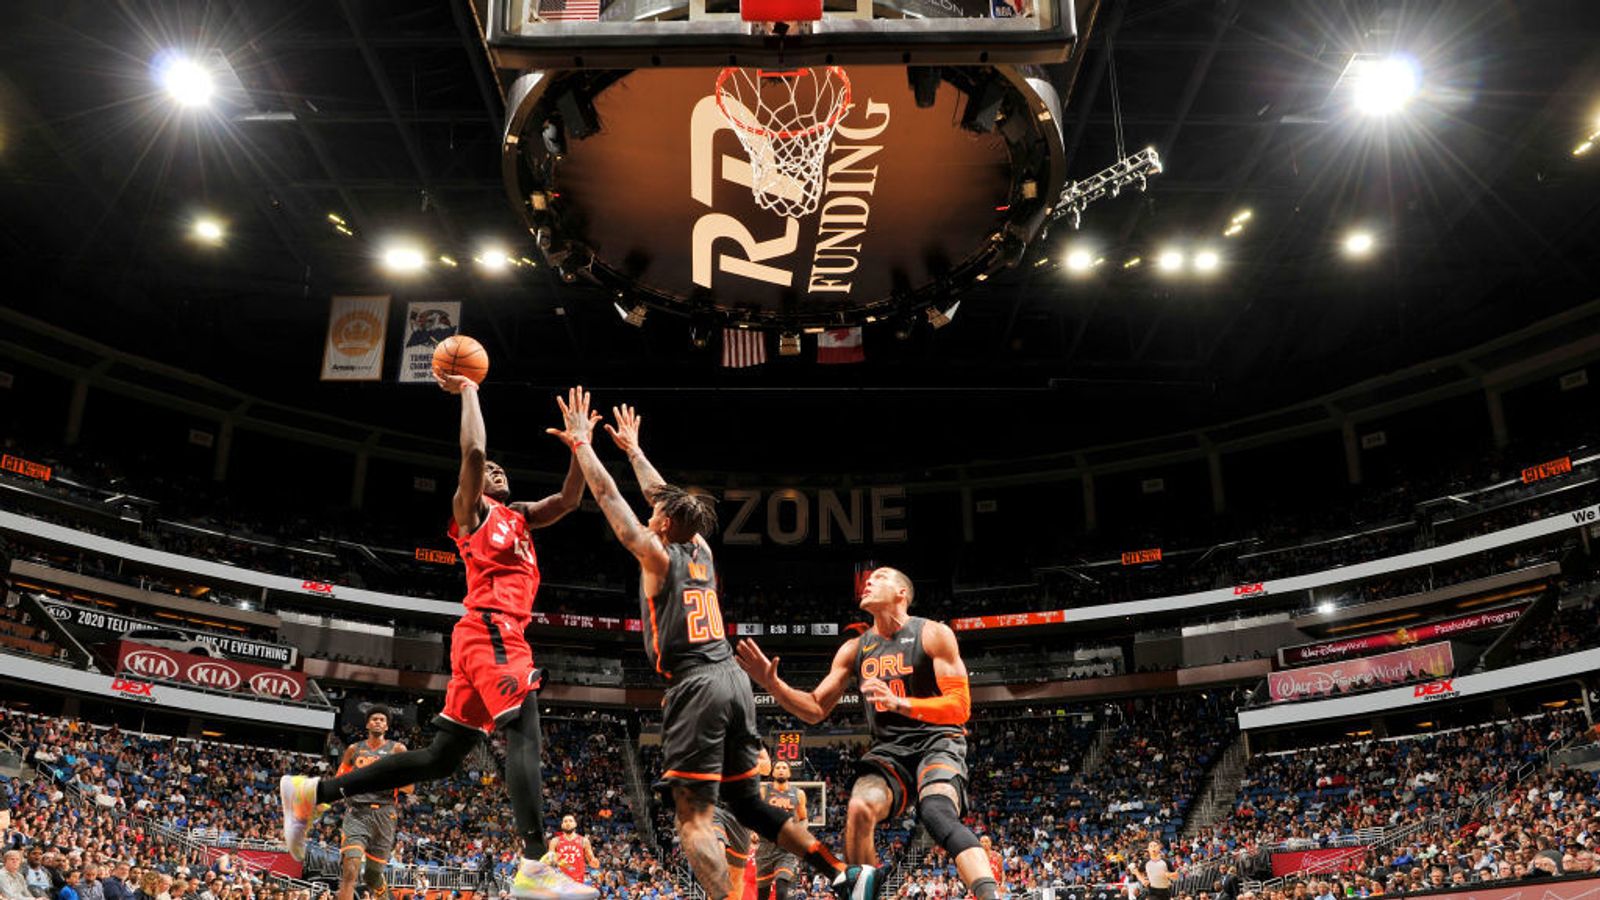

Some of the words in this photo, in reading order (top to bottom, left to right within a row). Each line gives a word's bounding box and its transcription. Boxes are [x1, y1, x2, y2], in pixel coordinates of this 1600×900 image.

[808, 98, 890, 294] FUNDING
[720, 487, 908, 545] ZONE
[1572, 510, 1595, 523] We
[302, 581, 334, 592] DEX
[1233, 583, 1264, 595] DEX
[683, 589, 726, 643] 20
[1481, 610, 1520, 625] Program
[49, 606, 68, 618] KIA
[78, 611, 104, 628] 2020
[220, 639, 230, 650] IT
[231, 640, 289, 661] EVERYTHING
[134, 654, 171, 677] KIA
[861, 652, 914, 680] ORL
[197, 667, 231, 687] KIA
[258, 677, 291, 695] KIA
[1276, 673, 1312, 697] Walt
[1371, 660, 1414, 681] World
[112, 679, 154, 696] DEX
[1414, 680, 1454, 697] DEX
[754, 695, 775, 705] GHT
[776, 742, 799, 760] 20
[563, 853, 575, 864] 23
